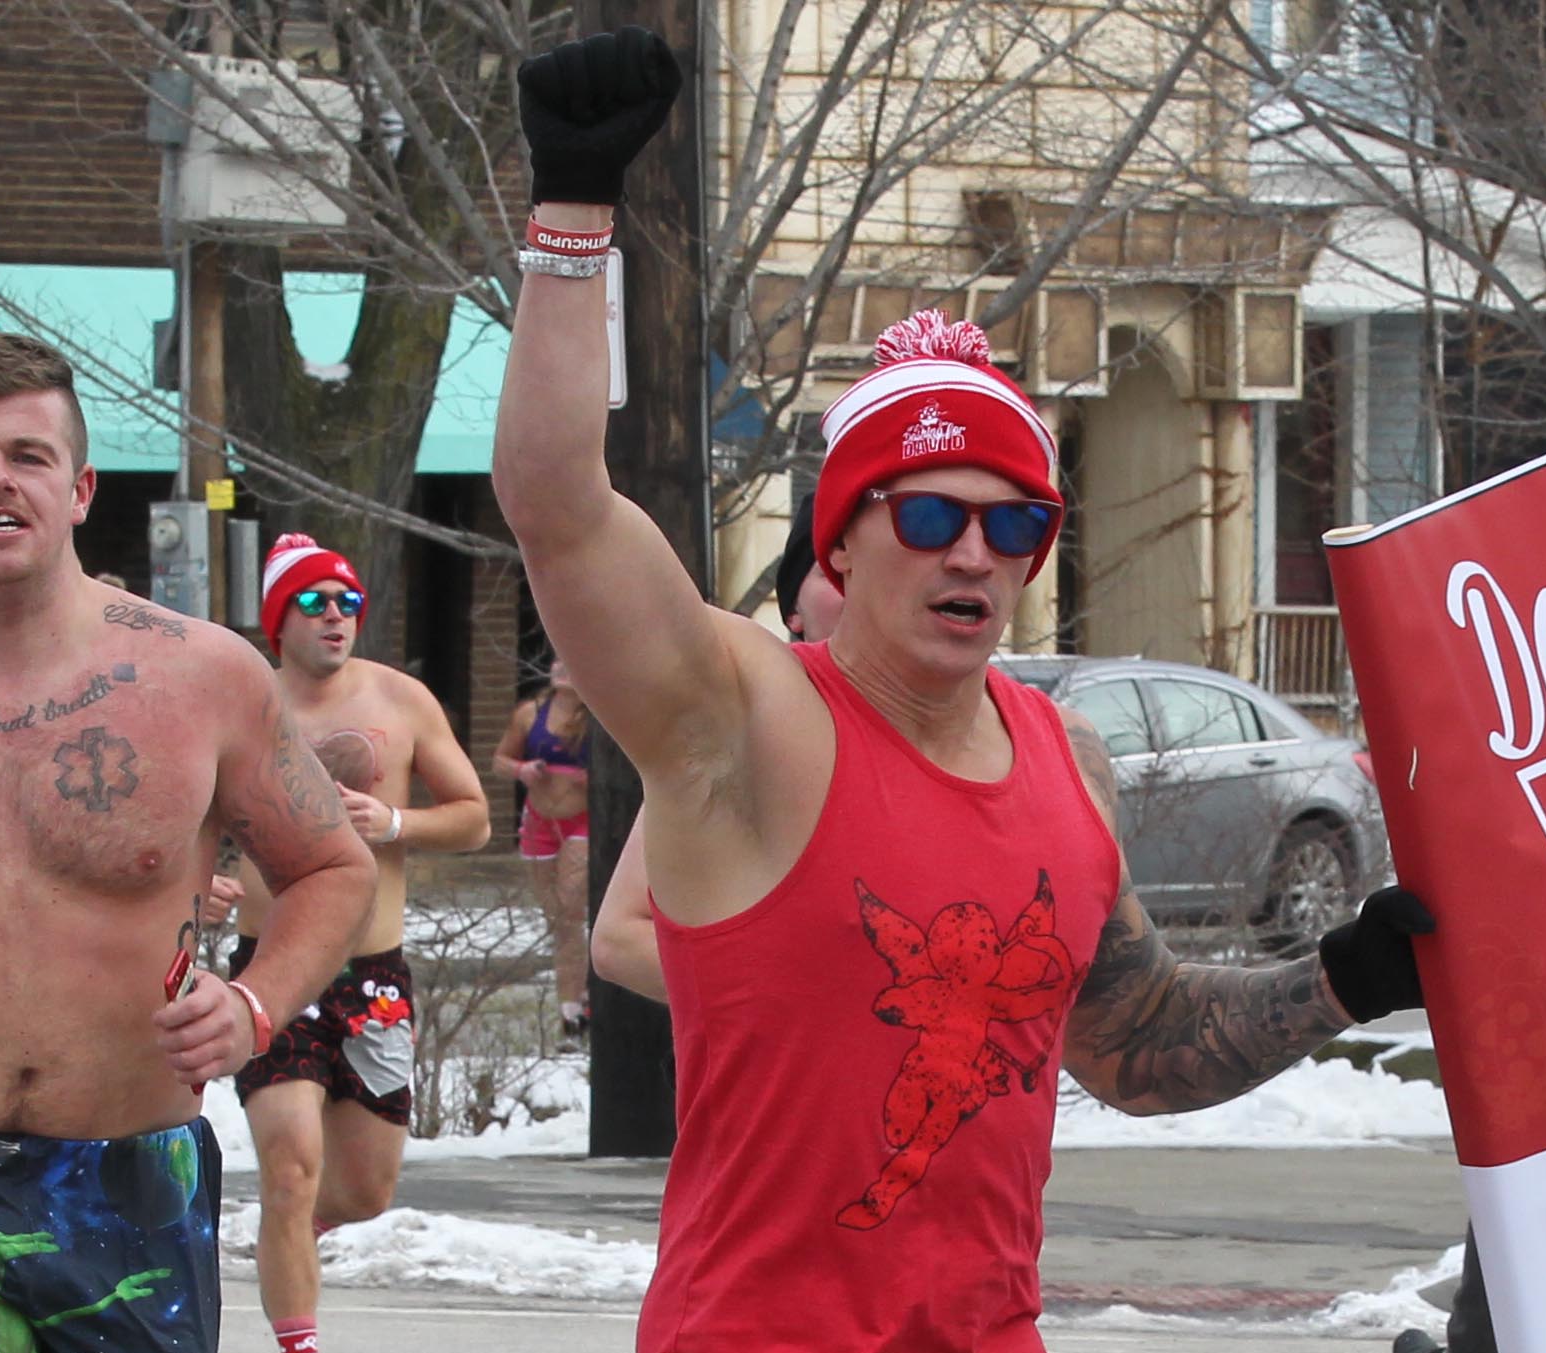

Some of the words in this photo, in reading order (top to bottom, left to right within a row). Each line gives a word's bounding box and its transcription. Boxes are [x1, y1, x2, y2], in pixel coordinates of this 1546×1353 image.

[945, 422, 966, 440] for
[901, 434, 966, 460] DAVID
[44, 674, 115, 722] breath
